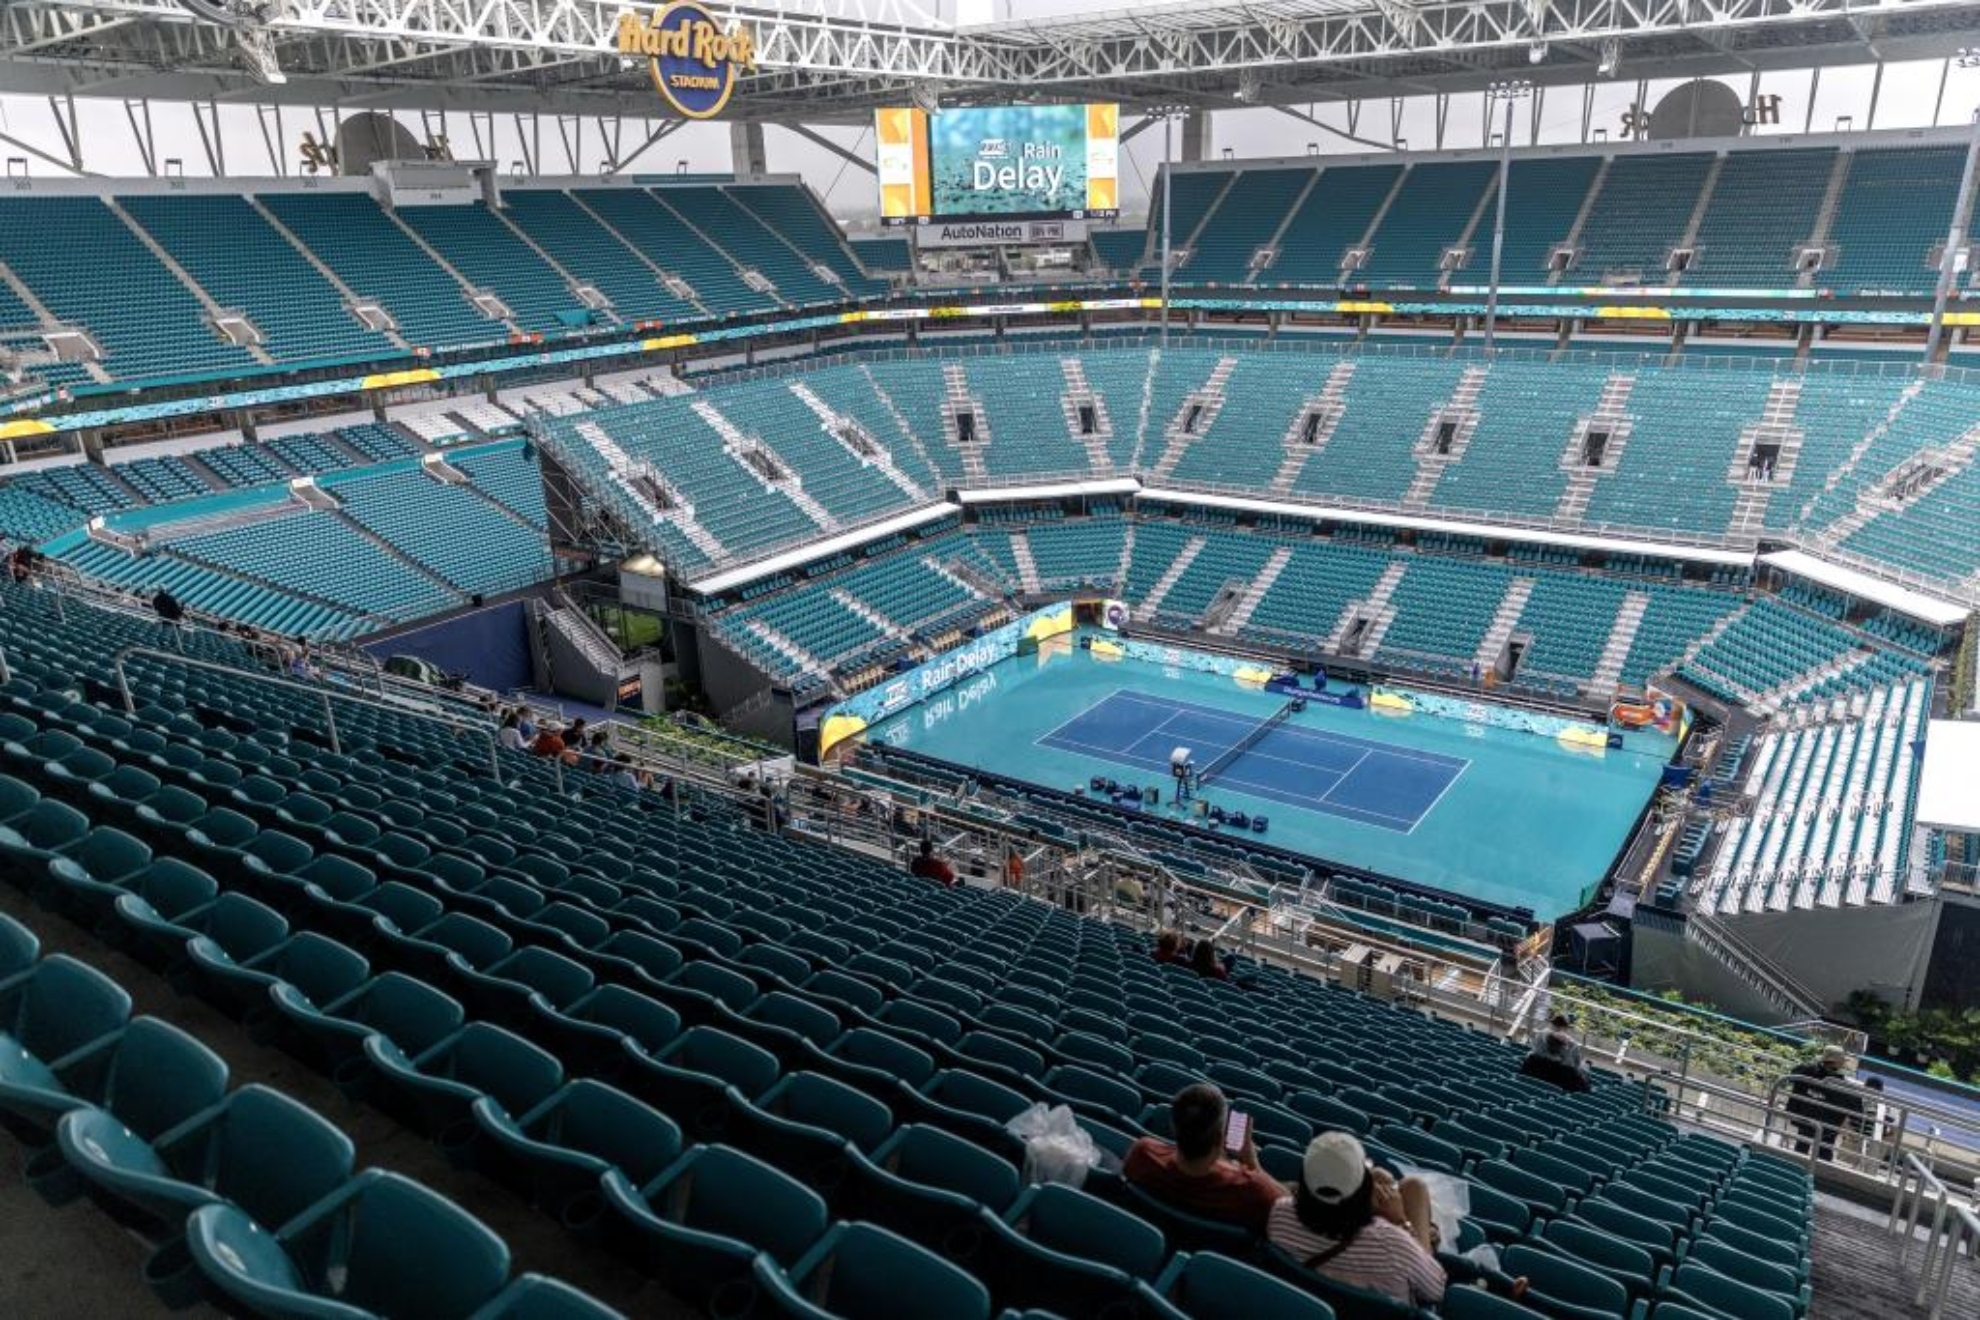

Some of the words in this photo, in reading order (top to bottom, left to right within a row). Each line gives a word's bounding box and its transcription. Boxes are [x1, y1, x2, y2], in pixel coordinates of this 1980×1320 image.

[618, 13, 691, 57] Hard
[692, 20, 757, 70] Rock
[670, 74, 720, 90] STADIUM
[1024, 141, 1061, 159] Rain
[974, 156, 1064, 196] Delay
[940, 224, 1022, 240] AutoNation
[957, 642, 996, 672] Delay
